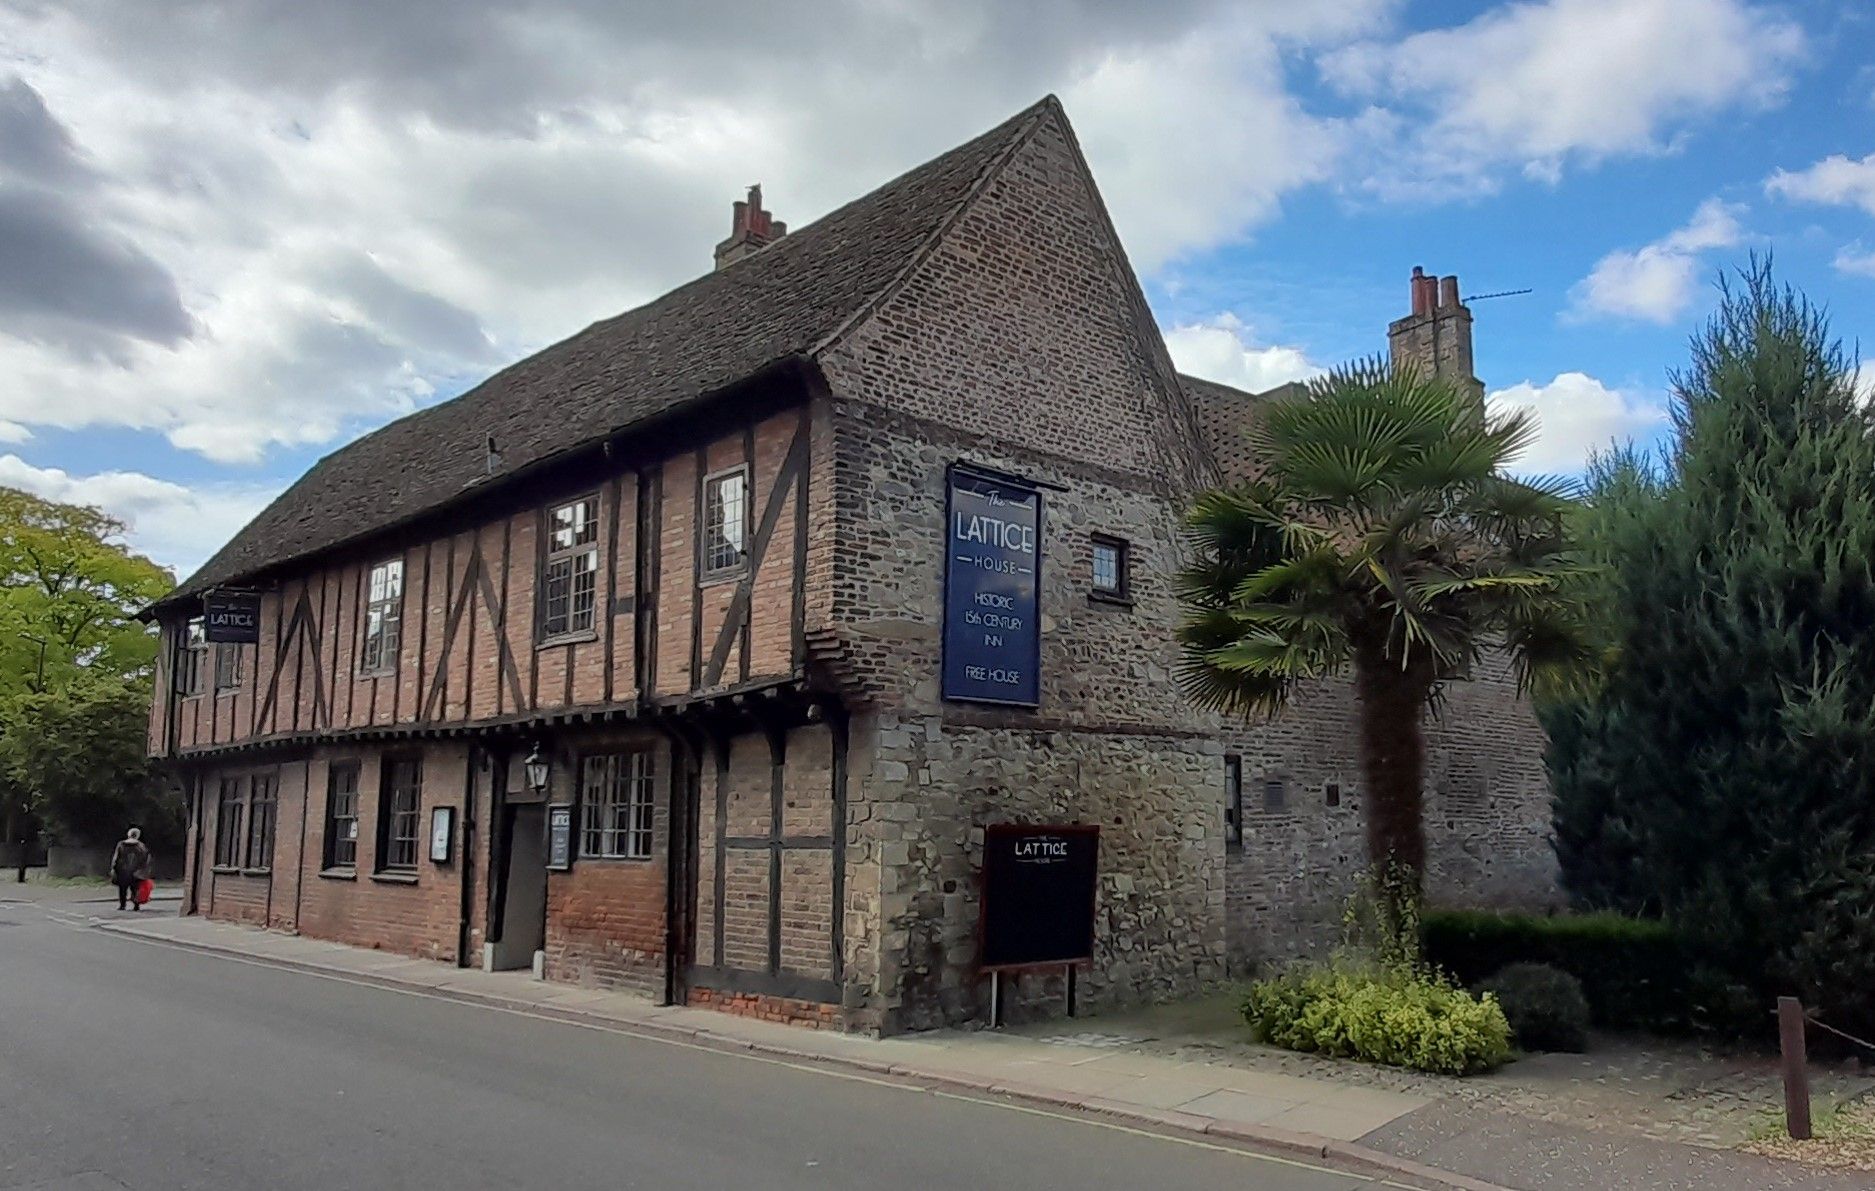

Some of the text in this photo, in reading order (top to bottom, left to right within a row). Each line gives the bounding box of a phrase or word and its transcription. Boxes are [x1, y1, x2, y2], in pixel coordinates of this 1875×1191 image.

[986, 490, 1006, 507] The
[956, 511, 1033, 553] LATTICE
[974, 556, 1016, 575] HOUSE
[974, 592, 1014, 610] HISTORIC
[211, 614, 253, 626] LATTICE
[983, 613, 1023, 630] CENTURY
[984, 634, 1003, 647] INN
[965, 665, 1021, 685] FREE HOUSE
[1014, 842, 1068, 856] LATTICE
